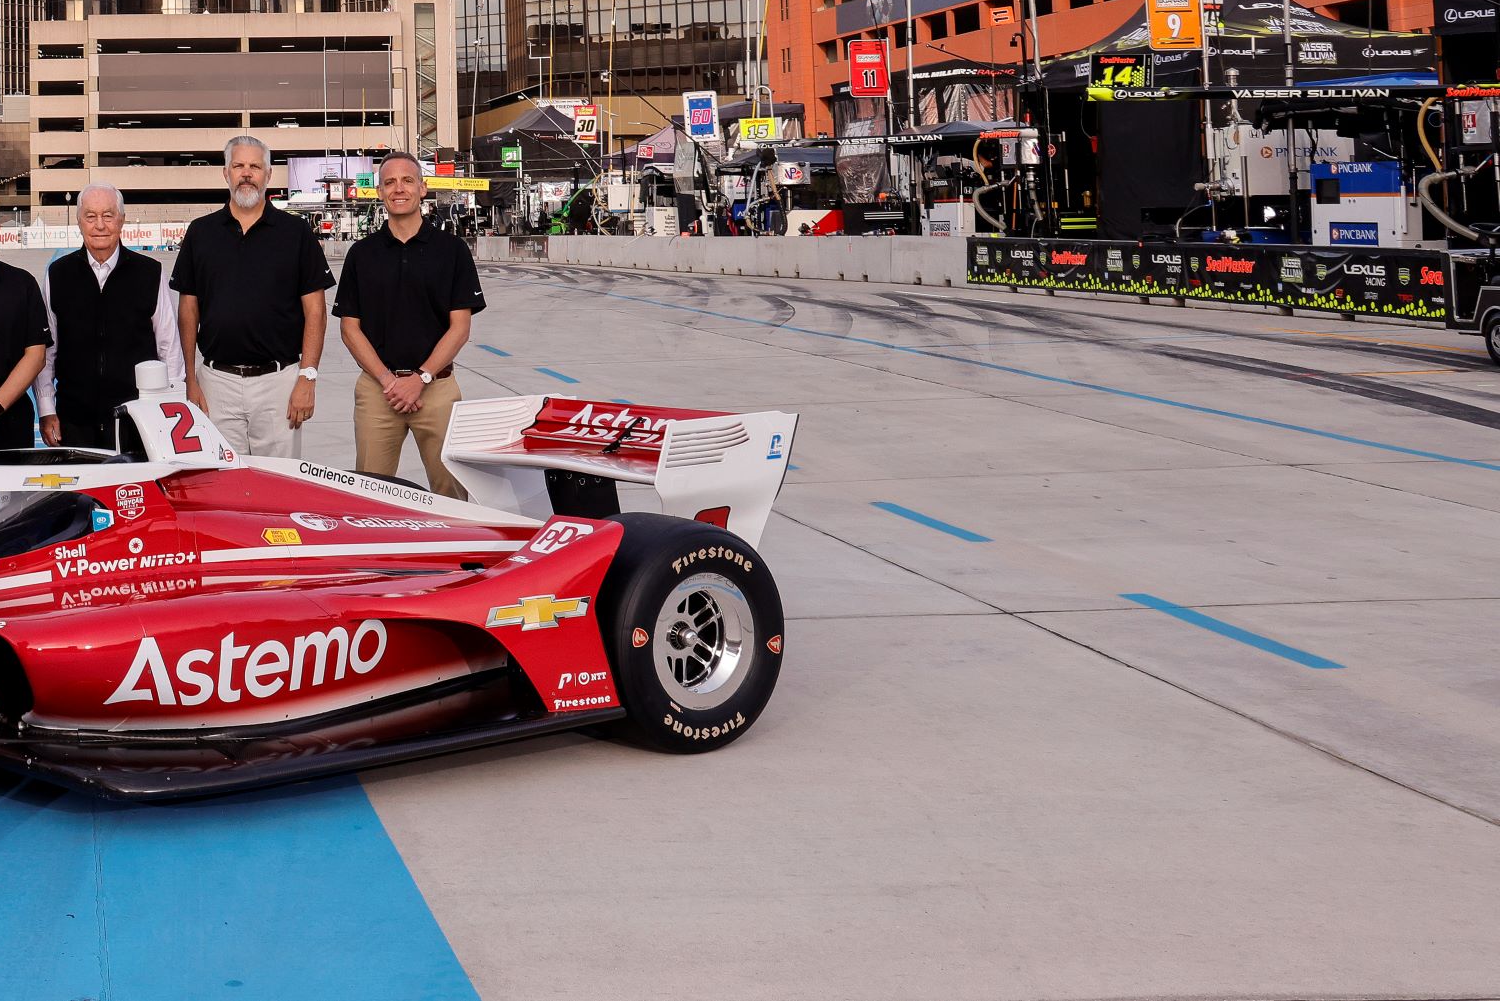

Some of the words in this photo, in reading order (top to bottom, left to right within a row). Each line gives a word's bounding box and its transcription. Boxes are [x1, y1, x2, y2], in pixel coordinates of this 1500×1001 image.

[1458, 9, 1496, 19] LEXUS
[1167, 13, 1182, 39] 9
[1299, 41, 1333, 52] VASSER
[1099, 56, 1136, 64] SealMaster
[1161, 54, 1182, 62] LEXUS
[1298, 52, 1337, 61] SULLIVAN
[862, 69, 877, 88] 11
[908, 71, 931, 80] AUL
[931, 68, 966, 78] MILLER
[1100, 65, 1133, 85] 14
[1128, 90, 1166, 98] LEXUS
[1232, 89, 1302, 99] VASSER
[1306, 88, 1390, 98] SULLIVAN
[690, 109, 712, 125] 60
[577, 119, 595, 133] 30
[747, 124, 769, 139] 15
[836, 137, 885, 146] VASSER
[887, 134, 943, 143] SULLIVAN
[979, 130, 1021, 139] SealMaster
[349, 188, 356, 196] 4
[30, 231, 68, 240] VIVID
[1010, 250, 1034, 259] LEXUS
[1051, 249, 1088, 266] SealMaster
[1151, 254, 1182, 265] LEXUS
[1205, 256, 1256, 273] SealMaster
[1343, 264, 1386, 276] LEXUS
[159, 401, 202, 455] 2
[299, 461, 356, 486] Clarience
[358, 478, 434, 506] TECHNOLOGIES
[128, 488, 141, 496] NTT
[116, 497, 144, 508] INDYCAR
[342, 515, 452, 531] Gallagher
[536, 525, 588, 551] PP
[54, 543, 87, 560] Shell
[671, 545, 753, 575] Firestone
[55, 556, 138, 578] V-Power
[102, 619, 388, 706] Astemo
[591, 672, 607, 681] NTT
[553, 694, 611, 710] Firestone
[663, 711, 747, 740] Firestone
